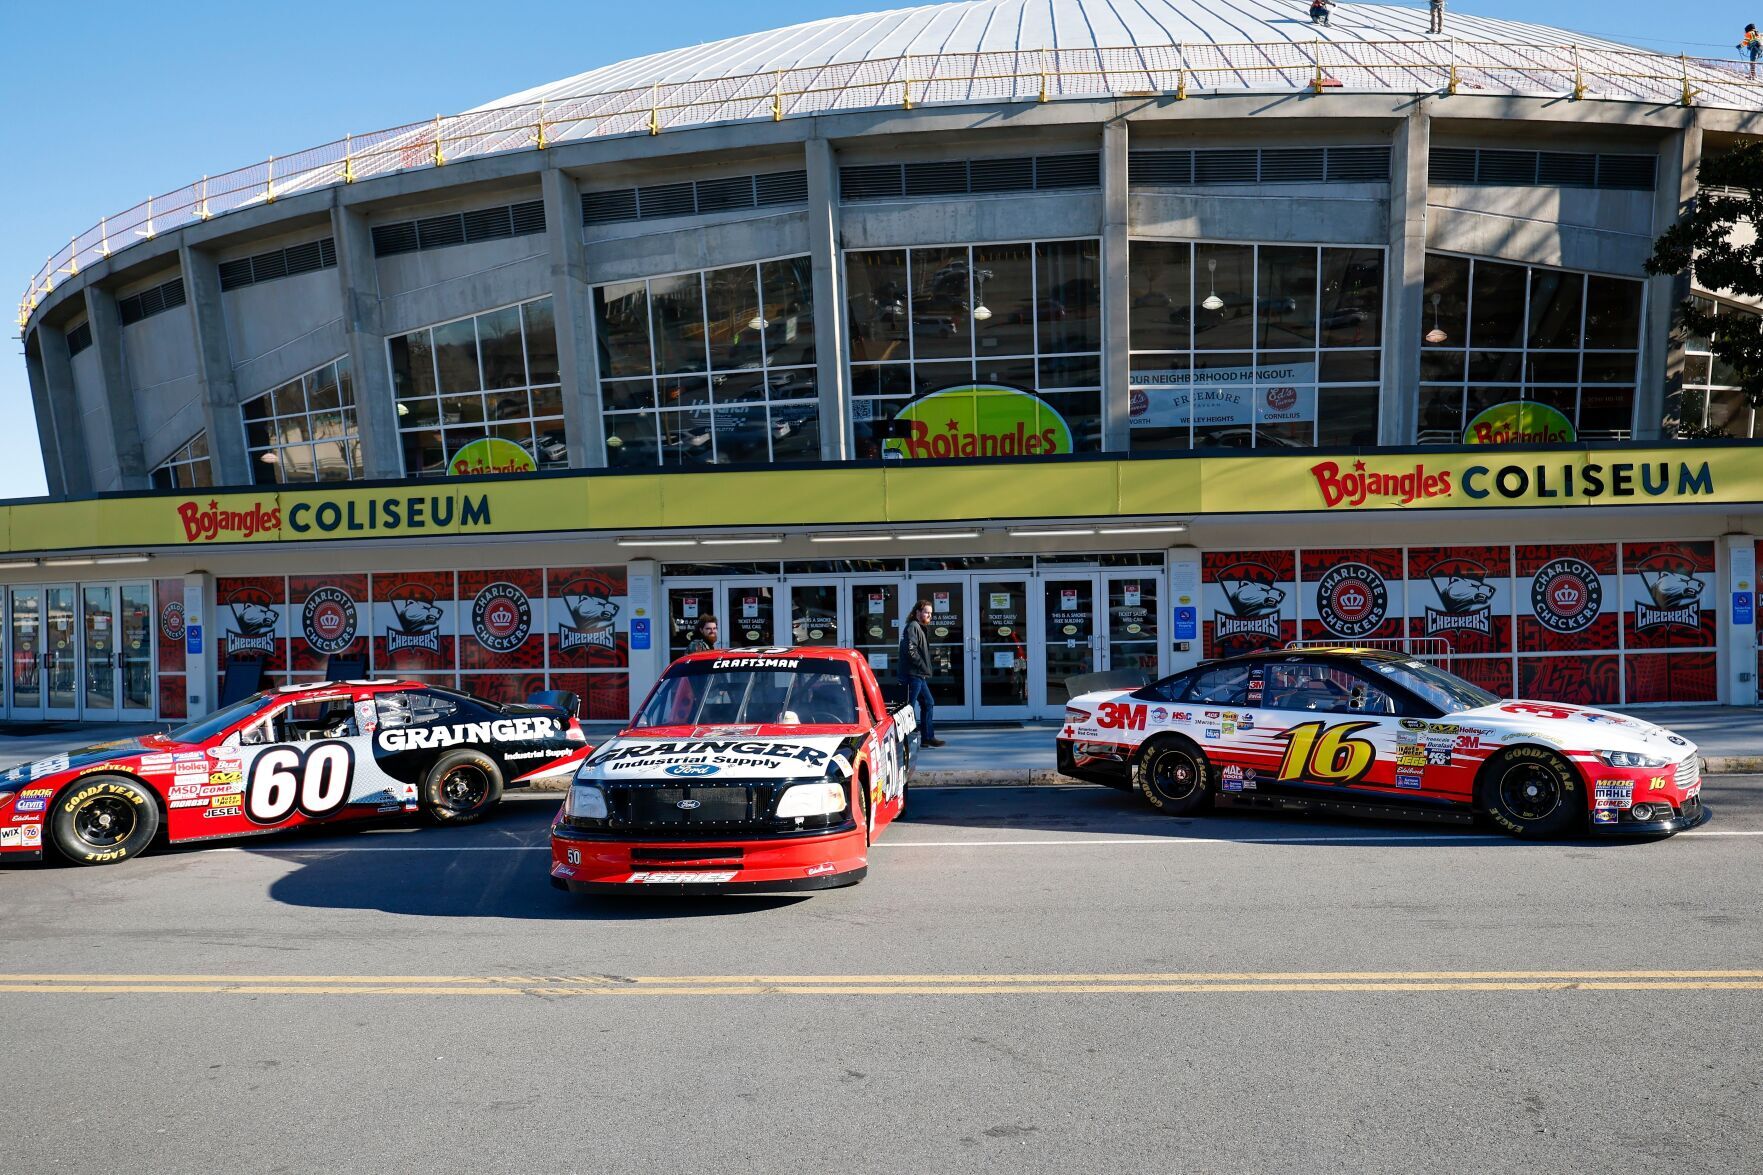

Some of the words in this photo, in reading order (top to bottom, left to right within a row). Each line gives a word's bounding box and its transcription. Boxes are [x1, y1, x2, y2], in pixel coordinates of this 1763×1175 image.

[1152, 372, 1237, 384] NEIGHBORHOOD
[1240, 369, 1295, 380] HANGOUT.
[903, 418, 1057, 459] Bojangles
[1473, 421, 1567, 444] Bojangles
[1310, 460, 1451, 508] Bojangles
[1461, 462, 1714, 499] COLISEUM
[177, 498, 281, 542] Bojangles
[288, 494, 492, 533] COLISEUM
[1321, 567, 1384, 597] CHARLOTTE
[1535, 562, 1598, 592] CHARLOTTE
[305, 590, 354, 618] CHARLOTTE
[476, 585, 527, 614] CHARLOTTE
[1321, 607, 1383, 634] CHECKERS
[1536, 601, 1598, 629] CHECKERS
[306, 626, 354, 651] CHECKERS
[476, 623, 528, 648] CHECKERS
[713, 659, 799, 668] CRAFTSMAN
[1248, 681, 1264, 689] 3M
[1096, 702, 1148, 731] 3M
[378, 716, 555, 751] GRAINGER
[1455, 736, 1480, 748] 3M
[1459, 727, 1482, 735] Holley
[504, 751, 544, 761] Industrial
[545, 748, 573, 758] Supply
[585, 741, 830, 767] GRAINGER
[612, 756, 712, 770] Industrial
[719, 755, 781, 769] Supply
[1273, 721, 1382, 786] 16
[177, 762, 207, 772] Holley
[673, 765, 712, 776] Ford
[1504, 747, 1575, 791] GOODYEAR
[20, 789, 53, 797] MOOG
[170, 785, 198, 795] MSD
[202, 786, 232, 794] COMP
[244, 739, 355, 826] 60
[1649, 776, 1667, 790] 16
[17, 800, 44, 810] CLEVITE
[64, 783, 144, 813] GOODYEAR
[204, 808, 241, 817] JESEL
[1489, 808, 1524, 833] EAGLE
[1, 828, 20, 838] WIX
[26, 828, 36, 836] 76
[85, 847, 127, 861] EAGLE
[567, 849, 581, 865] 50
